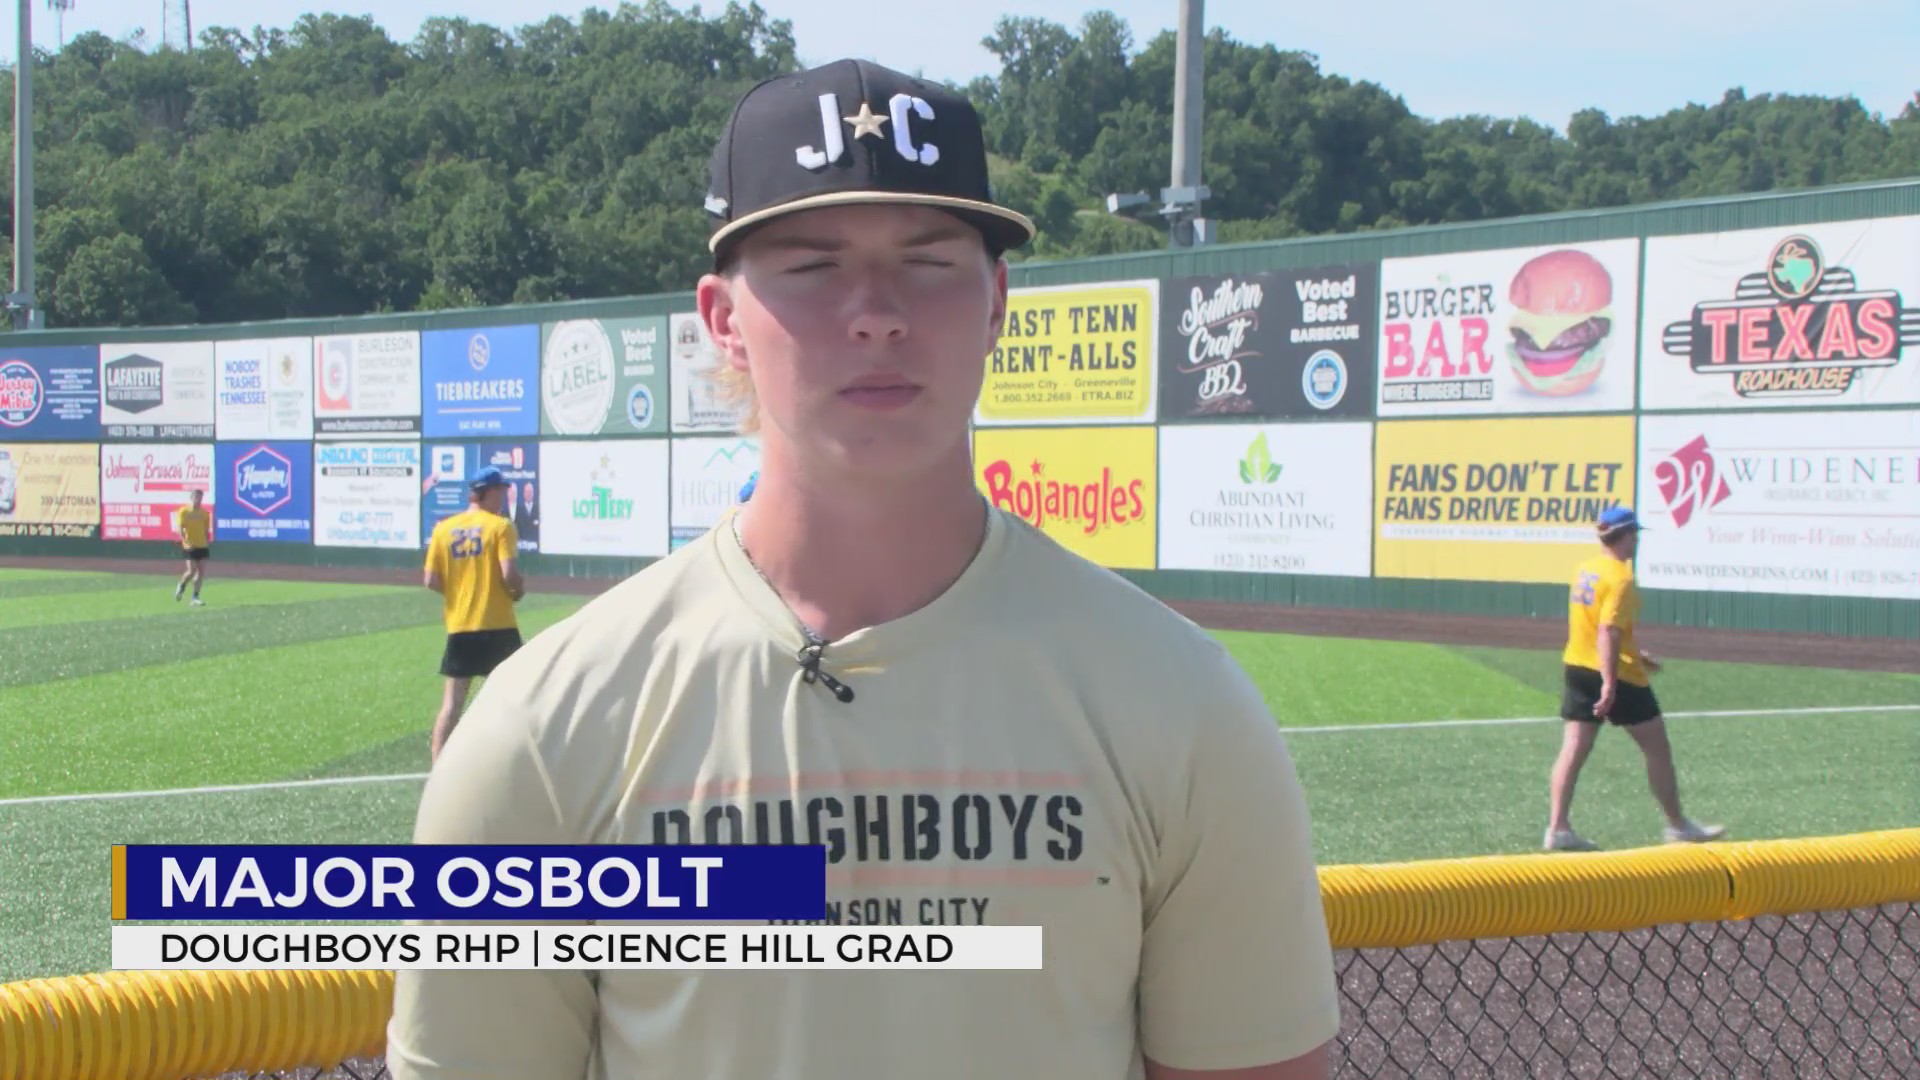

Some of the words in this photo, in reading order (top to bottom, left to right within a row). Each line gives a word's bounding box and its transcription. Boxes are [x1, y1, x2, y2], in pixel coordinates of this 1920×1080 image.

[1296, 276, 1356, 301] Voted
[1180, 279, 1263, 332] Southern
[1303, 300, 1348, 323] Best
[1385, 284, 1496, 319] BURGER
[1002, 307, 1056, 337] AST
[1069, 303, 1138, 334] TENN
[1702, 299, 1896, 364] TEXAS
[359, 337, 413, 352] BURLESON
[621, 326, 657, 345] Voted
[1189, 317, 1252, 364] Craft
[1290, 325, 1360, 343] BARBECUE
[1383, 317, 1493, 378] BAR
[106, 367, 160, 387] LAFAYETTE
[225, 360, 260, 373] NOBODY
[549, 357, 608, 398] LABEL
[225, 376, 261, 389] TRASHES
[436, 379, 524, 401] TIEBREAKERS
[992, 380, 1035, 391] Johnson
[1038, 379, 1058, 391] City
[1074, 377, 1136, 388] Greeneville
[1198, 360, 1247, 400] BBQ
[1737, 368, 1853, 391] ROADHOUSE
[220, 391, 266, 405] TENNESSEE
[105, 453, 140, 493] Johnny
[185, 453, 210, 480] Pizza
[1388, 463, 1458, 492] FANS
[1465, 460, 1558, 493] DON'T
[1565, 463, 1623, 493] LET
[572, 484, 633, 520] LOTTERY
[984, 458, 1143, 534] Bojangles
[1215, 489, 1305, 508] ABUNDANT
[1383, 496, 1442, 520] FANS
[1448, 497, 1520, 521] DRIVE
[1189, 510, 1273, 528] CHRISTIAN
[1279, 511, 1334, 530] LIVING
[1707, 526, 1744, 544] Your
[918, 898, 990, 926] CITY
